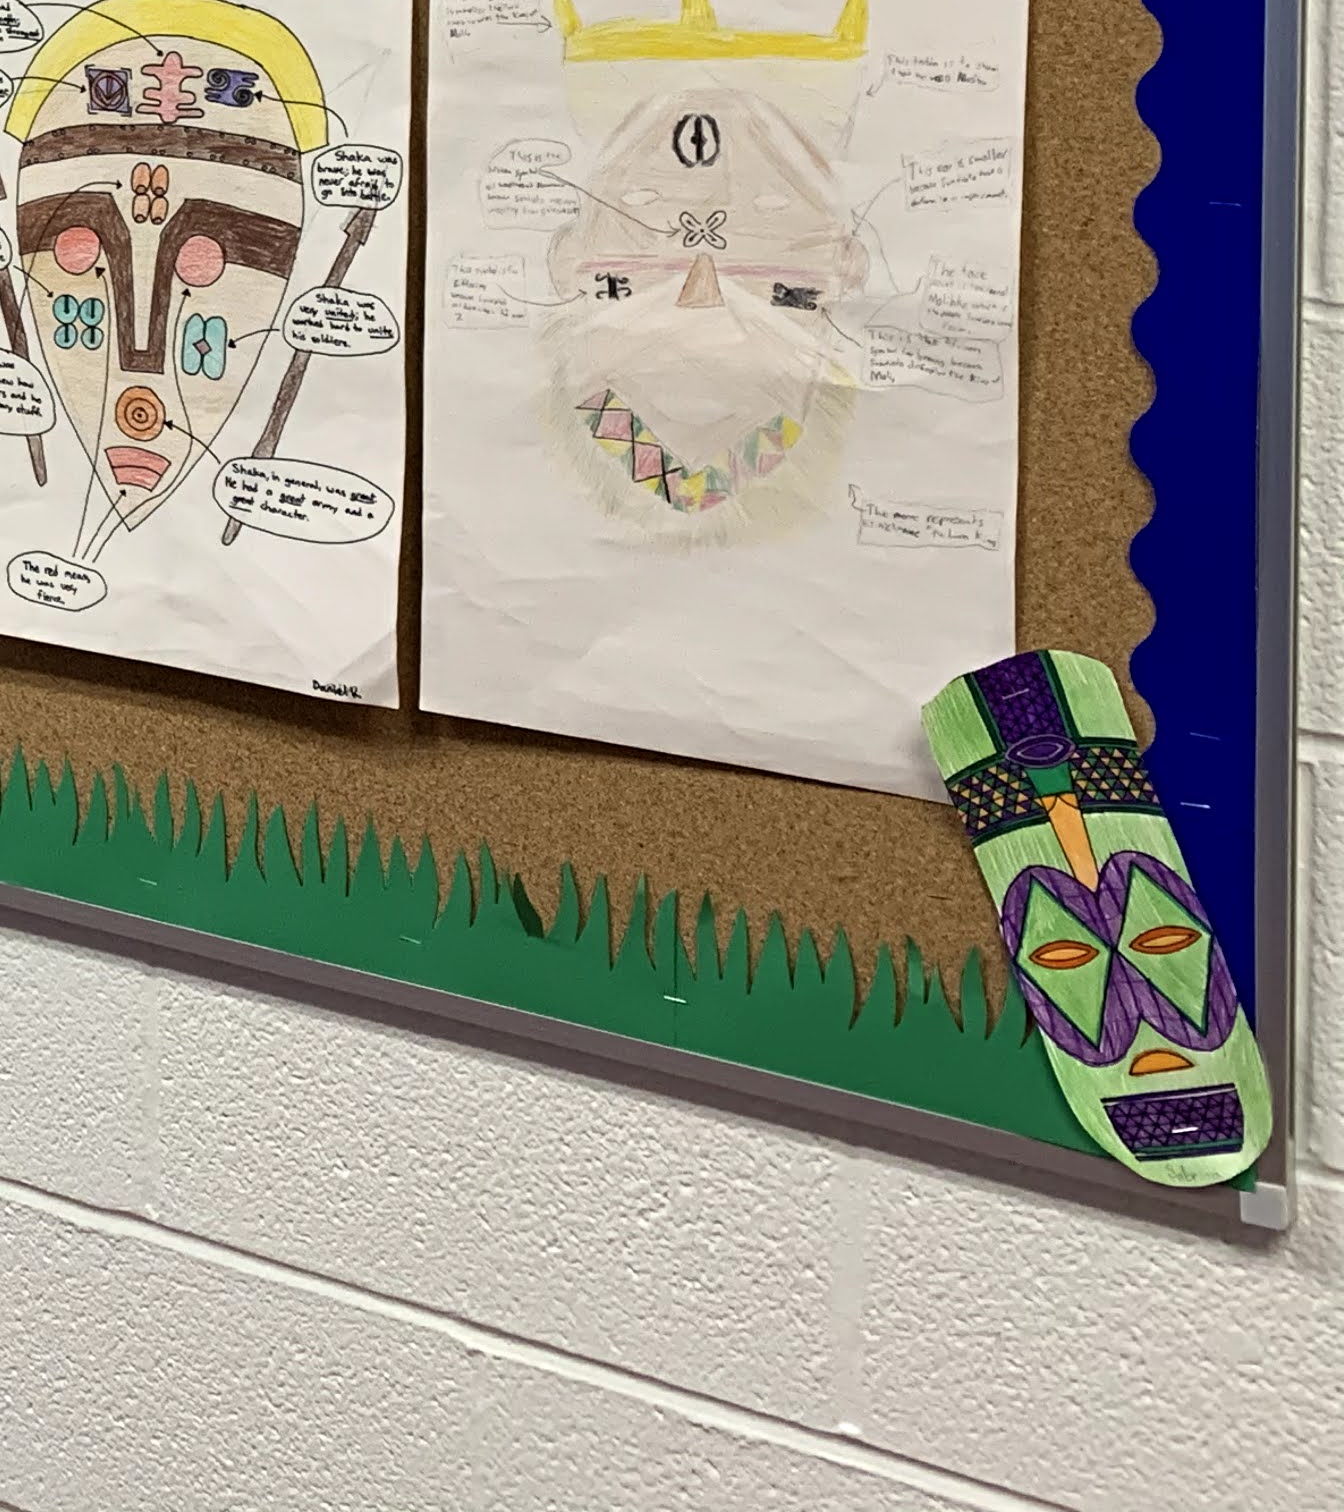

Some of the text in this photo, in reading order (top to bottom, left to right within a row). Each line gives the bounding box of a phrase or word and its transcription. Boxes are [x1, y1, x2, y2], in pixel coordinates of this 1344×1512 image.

[335, 150, 397, 165] Shaka was
[319, 178, 344, 186] never
[348, 177, 378, 190] afraid
[316, 293, 375, 310] Shaka was
[300, 306, 318, 317] very
[292, 319, 323, 328] worked
[330, 322, 350, 331] hard
[368, 326, 392, 335] unite
[292, 330, 306, 341] his
[17, 377, 34, 388] how
[232, 463, 269, 481] Shaka,
[284, 478, 321, 492] general,
[326, 486, 346, 498] was
[350, 492, 377, 503] great
[225, 476, 237, 489] He
[242, 480, 258, 493] had
[279, 492, 306, 504] great
[312, 500, 338, 514] army
[344, 508, 362, 517] and
[231, 495, 310, 522] great character.
[23, 560, 58, 577] The red
[60, 583, 77, 595] very
